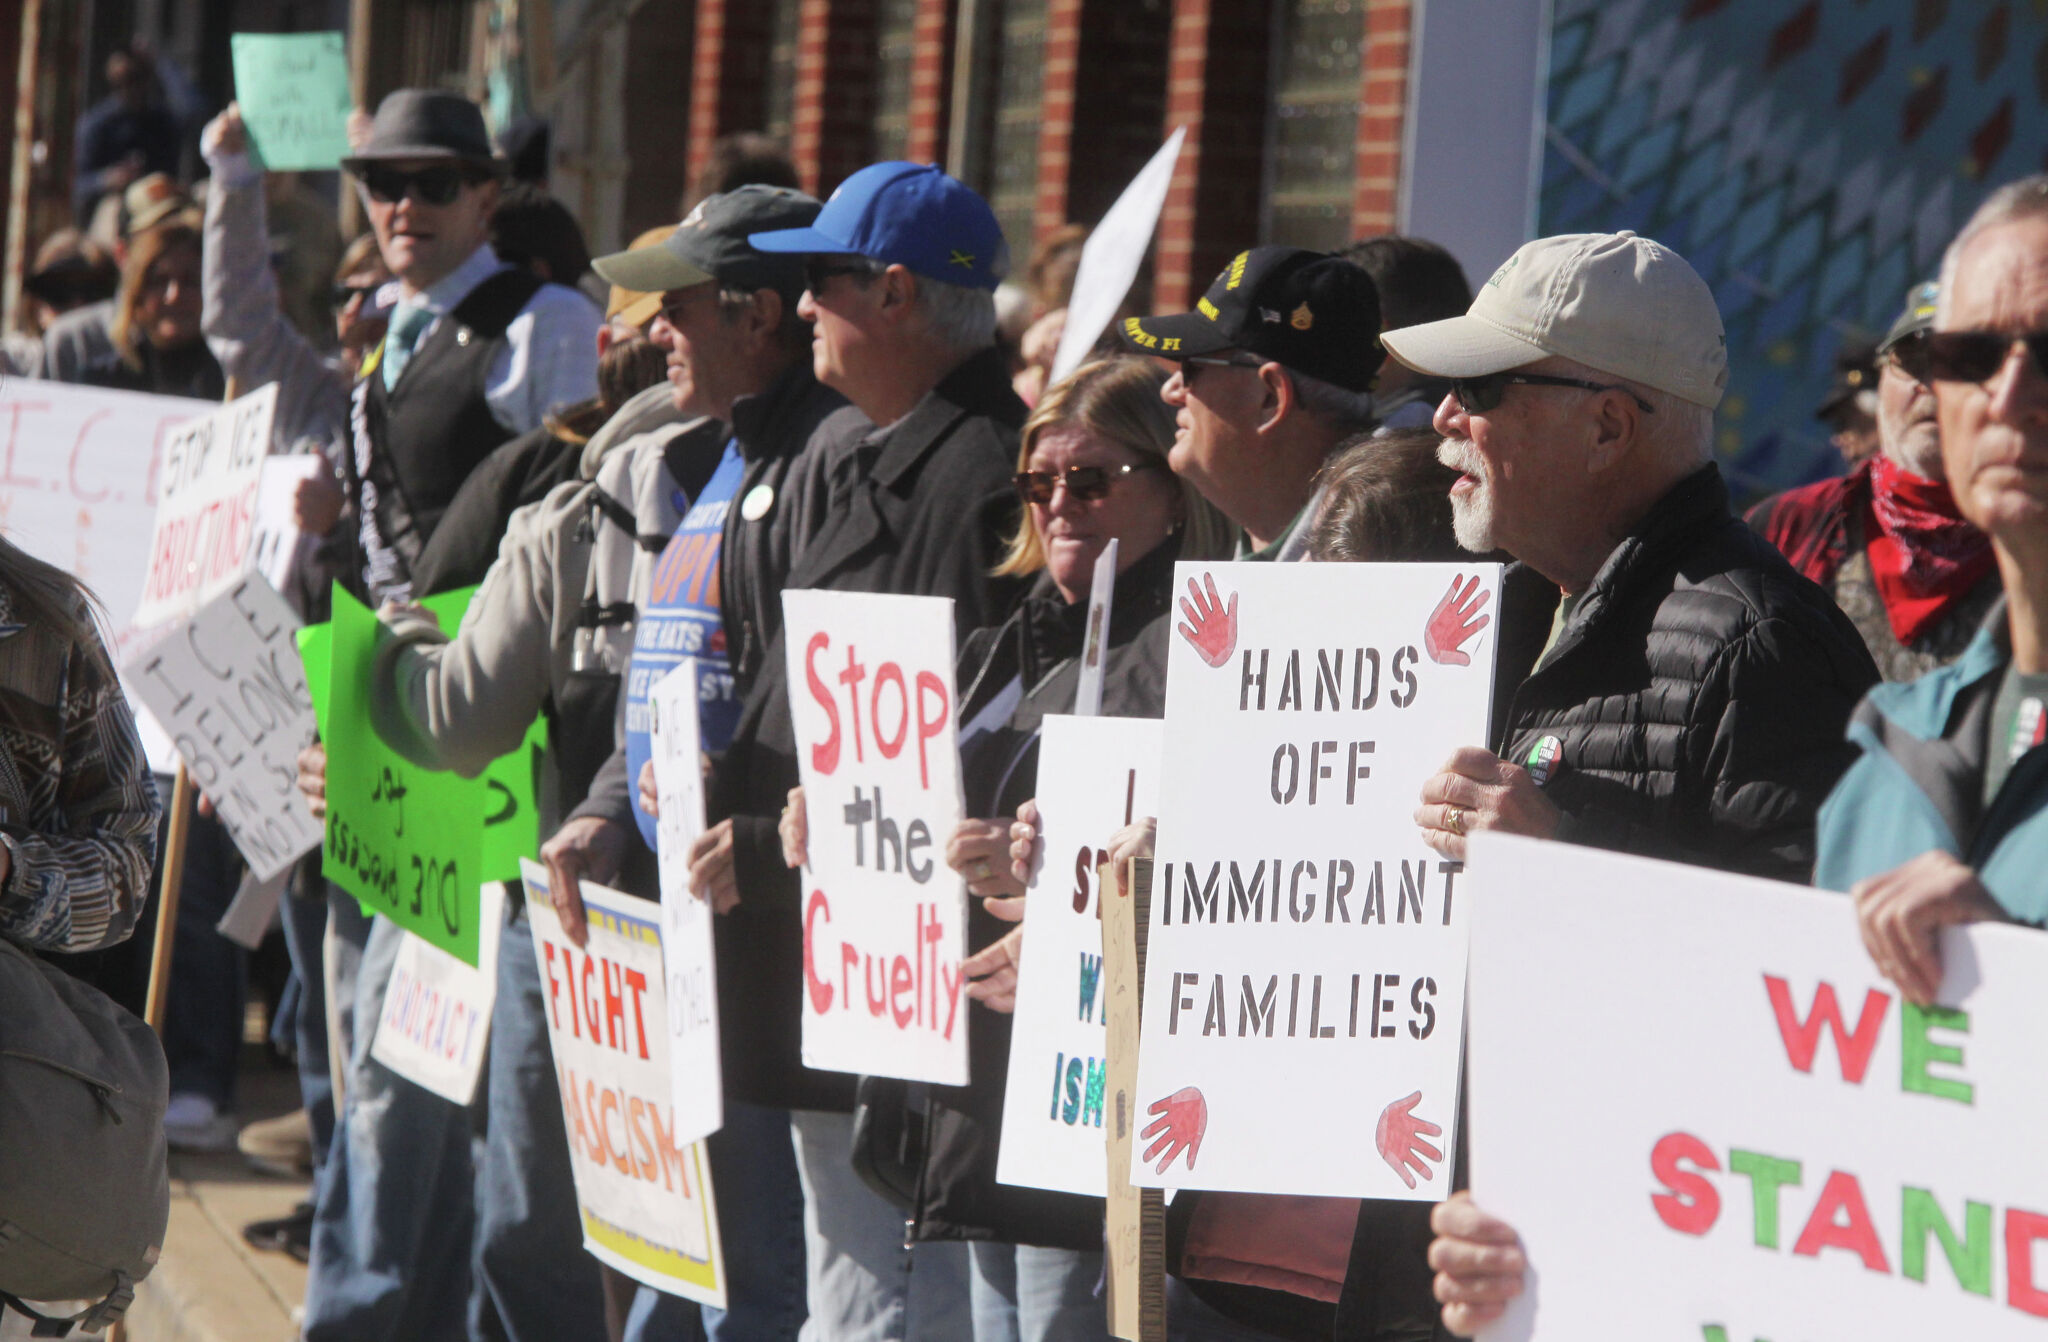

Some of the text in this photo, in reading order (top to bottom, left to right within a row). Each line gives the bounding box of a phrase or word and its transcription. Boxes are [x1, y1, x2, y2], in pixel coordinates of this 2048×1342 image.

[1161, 337, 1182, 350] FI
[164, 402, 263, 498] STOP ICE
[1238, 645, 1420, 713] HANDS
[1270, 740, 1377, 806] OFF
[843, 785, 934, 884] the
[410, 852, 460, 937] DUE
[1162, 858, 1465, 927] IMMIGRANT
[543, 939, 651, 1061] FIGHT
[802, 889, 963, 1042] Cruelty
[1168, 971, 1439, 1042] FAMILIES
[1761, 972, 1976, 1106] WE
